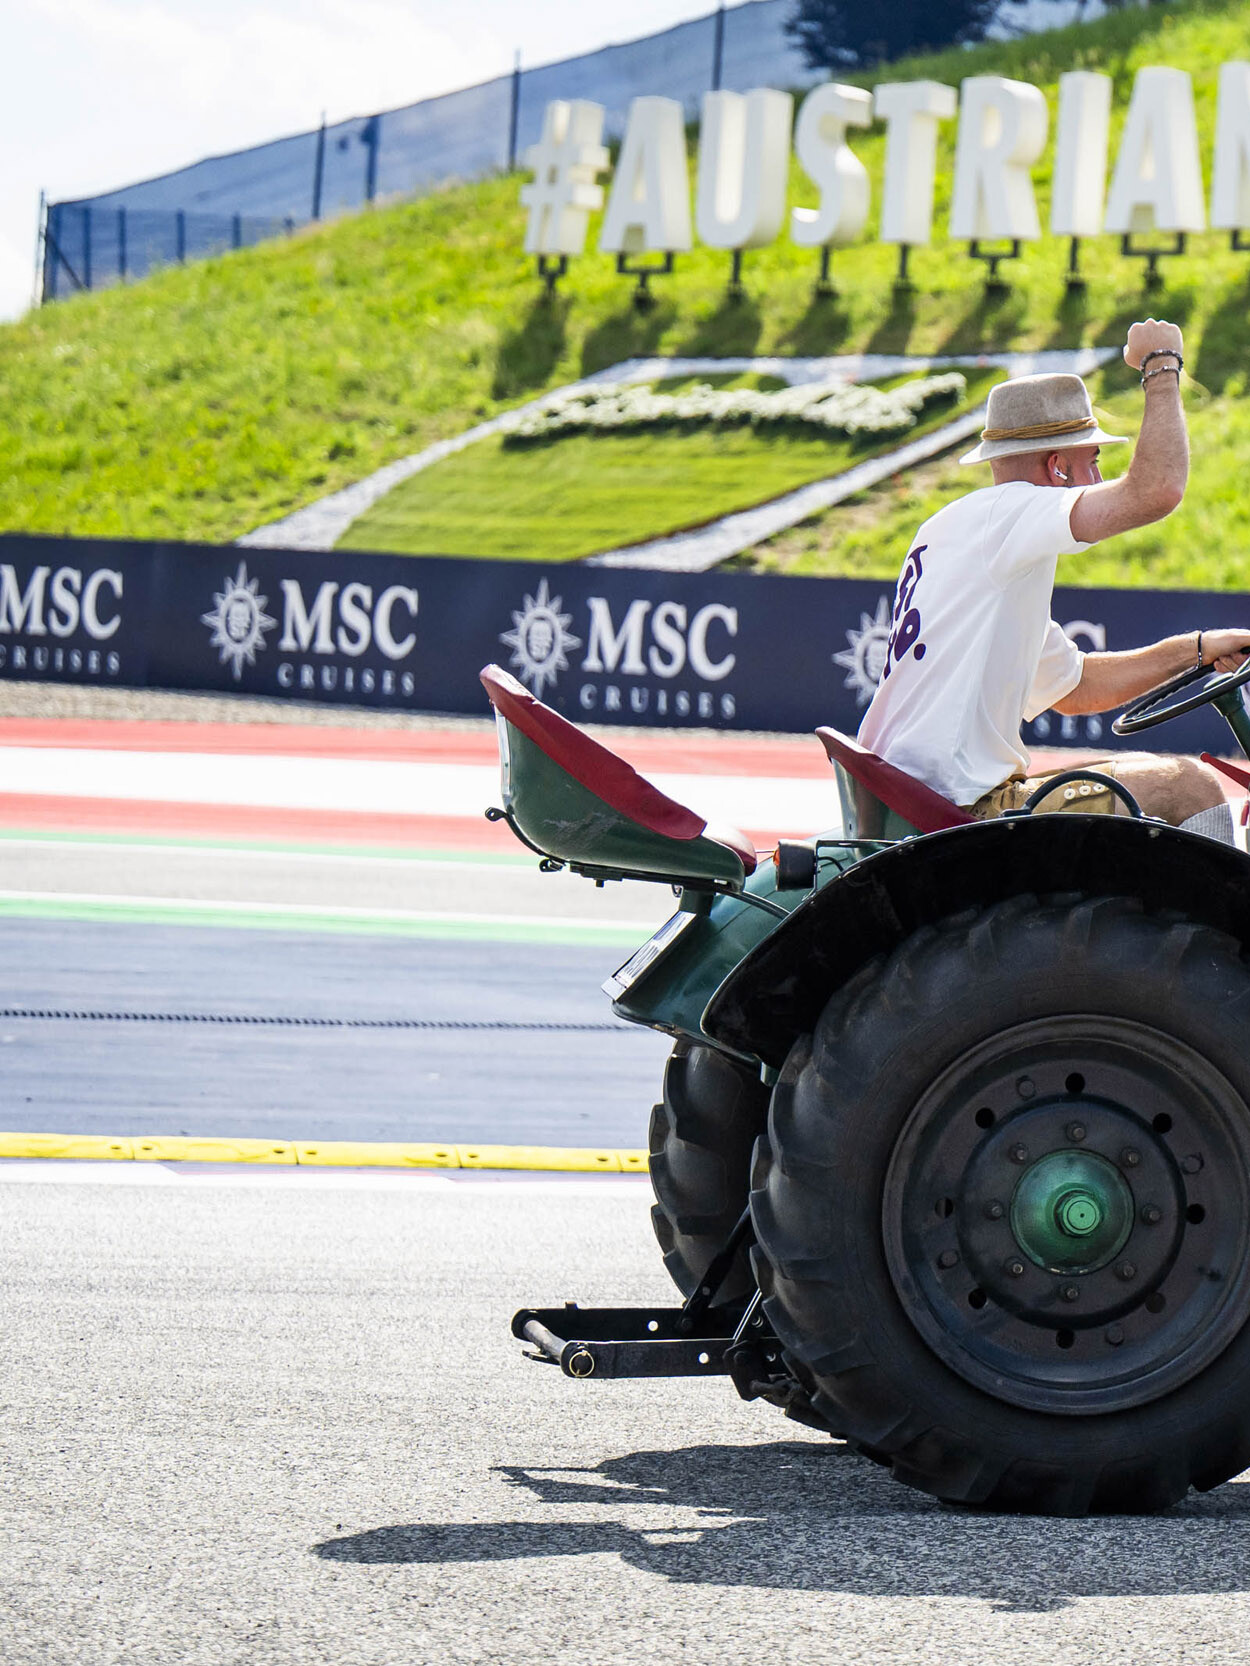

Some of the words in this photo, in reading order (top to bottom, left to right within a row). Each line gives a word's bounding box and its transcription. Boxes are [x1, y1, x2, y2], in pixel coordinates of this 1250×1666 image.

[0, 564, 123, 640] MSC
[278, 579, 418, 660] MSC
[581, 597, 738, 681] MSC
[277, 662, 416, 697] CRUISES
[579, 684, 737, 720] CRUISES
